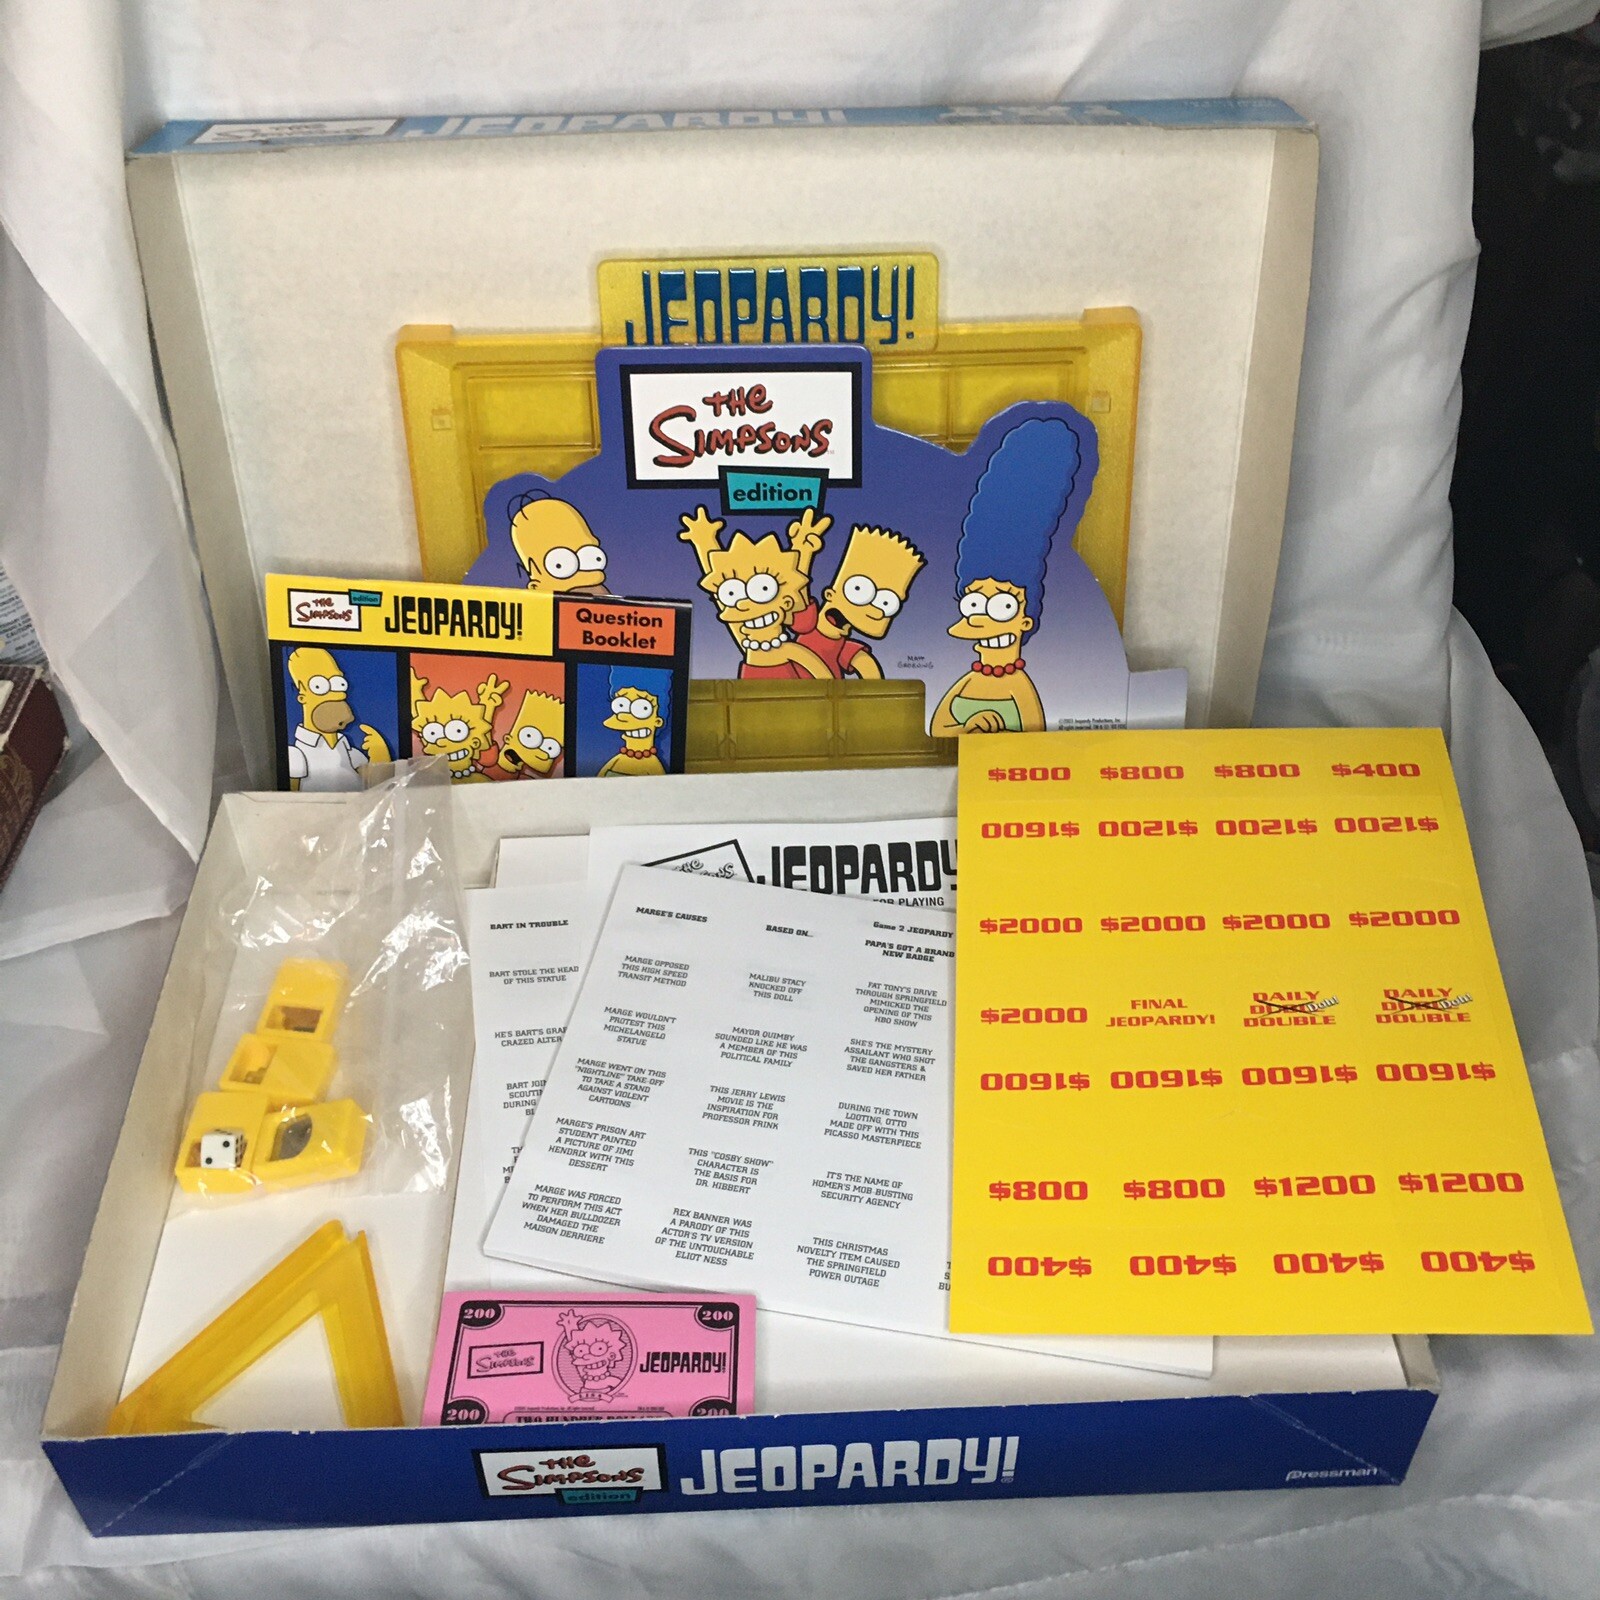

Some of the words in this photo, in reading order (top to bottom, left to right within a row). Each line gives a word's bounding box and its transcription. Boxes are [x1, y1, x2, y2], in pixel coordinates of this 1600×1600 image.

[625, 265, 915, 345] JEOPARDY!
[733, 483, 813, 501] edition
[385, 595, 522, 640] JEOPARDY!
[576, 607, 663, 628] Question
[582, 630, 657, 649] Booklet
[988, 767, 1071, 781] $800
[1100, 766, 1184, 780] $800
[1214, 764, 1300, 778] $800
[1332, 764, 1420, 777] $400
[981, 823, 1079, 838] $1600
[1098, 821, 1198, 837] $1200
[1215, 819, 1317, 835] $1200
[1334, 817, 1439, 833] $1200
[899, 896, 944, 908] PLAYING
[635, 906, 674, 918] MARGE'S
[675, 912, 708, 923] CAUSES
[1222, 914, 1330, 930] $2000
[1348, 910, 1460, 926] $2000
[527, 920, 569, 928] TROUBLE
[765, 924, 795, 935] BASED
[873, 921, 897, 931] Game
[906, 926, 954, 939] JEOPARDY
[980, 918, 1082, 934] $2000
[1100, 916, 1206, 932] $2000
[864, 939, 895, 950] PAPA'S
[896, 944, 915, 952] GOT
[915, 946, 922, 954] A
[923, 947, 955, 959] BRAND
[882, 949, 905, 958] NEW
[905, 953, 935, 963] BADGE
[489, 970, 511, 978] BART
[512, 968, 538, 977] STOLE
[538, 967, 556, 975] THE
[536, 974, 567, 983] STATUE
[1252, 991, 1319, 1002] DAILY
[1383, 988, 1453, 999] DAILY
[1131, 998, 1188, 1009] FINAL
[981, 1008, 1087, 1024] $2000
[1106, 1014, 1216, 1028] JEOPARDY!
[1244, 1016, 1336, 1027] DOUBLE
[1376, 1012, 1471, 1024] DOUBLE
[515, 1028, 544, 1037] BART'S
[501, 1038, 534, 1047] CRAZED
[537, 1036, 563, 1044] ALTER
[1110, 1070, 1223, 1089] $1600
[1242, 1066, 1357, 1085] $1600
[1376, 1064, 1495, 1081] $1600
[506, 1081, 528, 1090] BART
[980, 1073, 1090, 1091] $1600
[503, 1099, 537, 1109] DURING
[688, 1147, 709, 1158] THIS
[696, 1158, 748, 1174] CHARACTER
[749, 1167, 760, 1176] IS
[694, 1167, 712, 1178] THE
[712, 1171, 739, 1183] BASIS
[740, 1175, 758, 1186] FOR
[844, 1173, 862, 1183] THE
[863, 1176, 890, 1188] NAME
[891, 1180, 903, 1189] OF
[1398, 1173, 1524, 1193] $1200
[711, 1181, 752, 1194] HIBBERT
[811, 1179, 851, 1192] HOMER'S
[988, 1181, 1088, 1201] $800
[1123, 1179, 1225, 1199] $800
[1254, 1175, 1375, 1197] $1200
[534, 1184, 567, 1196] MARGE
[567, 1189, 587, 1200] WAS
[587, 1192, 622, 1205] FORCED
[820, 1190, 865, 1204] SECURITY
[865, 1197, 901, 1209] AGENCY
[528, 1192, 540, 1201] TO
[539, 1195, 583, 1210] PERFORM
[583, 1202, 604, 1213] THIS
[604, 1206, 623, 1216] ACT
[522, 1201, 550, 1213] WHEN
[549, 1207, 569, 1218] HER
[569, 1210, 621, 1227] BULLDOZER
[672, 1207, 692, 1218] REX
[692, 1211, 730, 1225] BANNER
[733, 1218, 753, 1228] WAS
[536, 1214, 580, 1229] DAMAGED
[581, 1222, 600, 1233] THE
[669, 1218, 677, 1226] A
[678, 1219, 715, 1232] PARODY
[715, 1225, 728, 1234] OF
[729, 1227, 750, 1239] THIS
[523, 1221, 559, 1235] MAISON
[559, 1229, 606, 1245] DERRIERE
[661, 1227, 698, 1240] ACTOR'S
[699, 1233, 713, 1242] TV
[714, 1235, 754, 1249] VERSION
[654, 1236, 668, 1245] OF
[668, 1238, 688, 1249] THE
[688, 1241, 755, 1260] UNTOUCHABLE
[812, 1236, 834, 1248] THIS
[835, 1240, 889, 1256] CHRISTMAS
[675, 1250, 703, 1262] ELIOT
[703, 1255, 728, 1266] NESS
[796, 1245, 838, 1259] NOVELTY
[838, 1251, 863, 1263] ITEM
[864, 1256, 901, 1269] CAUSED
[1273, 1253, 1384, 1274] $400
[1420, 1252, 1535, 1272] $400
[806, 1257, 825, 1267] THE
[826, 1260, 887, 1278] SPRINGFIELD
[987, 1257, 1092, 1277] $400
[1129, 1256, 1236, 1276] $400
[808, 1268, 842, 1281] POWER
[844, 1274, 880, 1288] OUTAGE
[464, 1308, 495, 1319] 200
[702, 1310, 733, 1320] 200
[640, 1351, 726, 1374] JEOPARDY!
[446, 1408, 480, 1421] 200
[680, 1435, 1020, 1496] JEOPARDY!
[567, 1492, 631, 1501] edition
